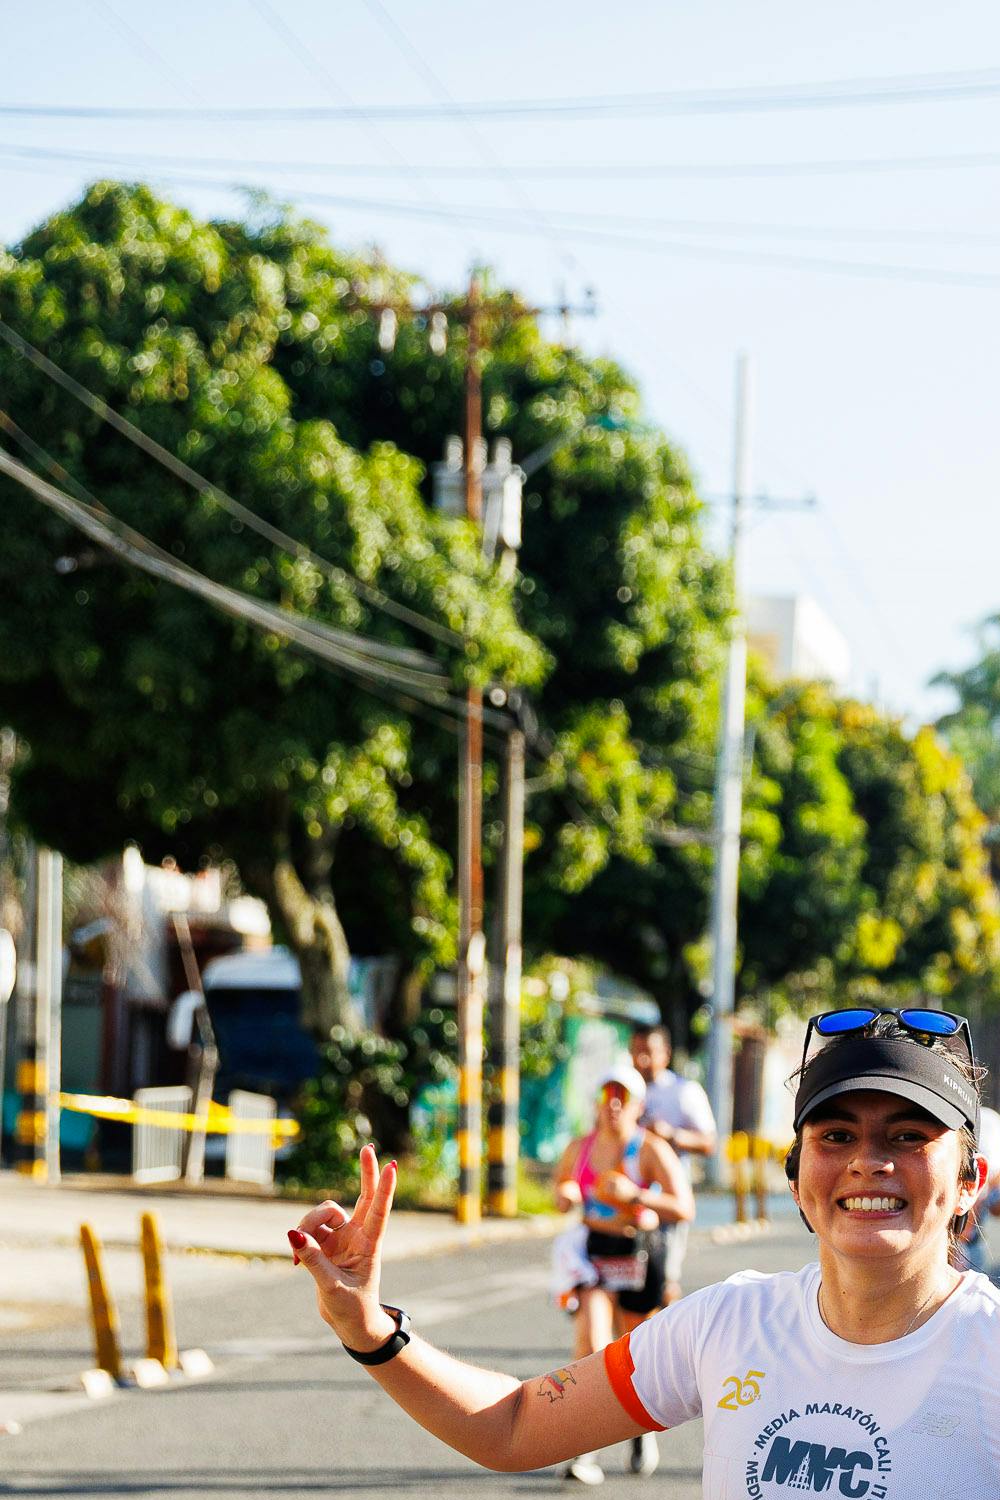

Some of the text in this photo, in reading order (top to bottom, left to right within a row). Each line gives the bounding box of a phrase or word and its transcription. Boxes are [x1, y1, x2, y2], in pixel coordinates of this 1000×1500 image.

[717, 1370, 766, 1411] 25
[754, 1408, 800, 1450] MEDIA
[805, 1402, 881, 1436] MARATÓN
[873, 1436, 892, 1473] CALI
